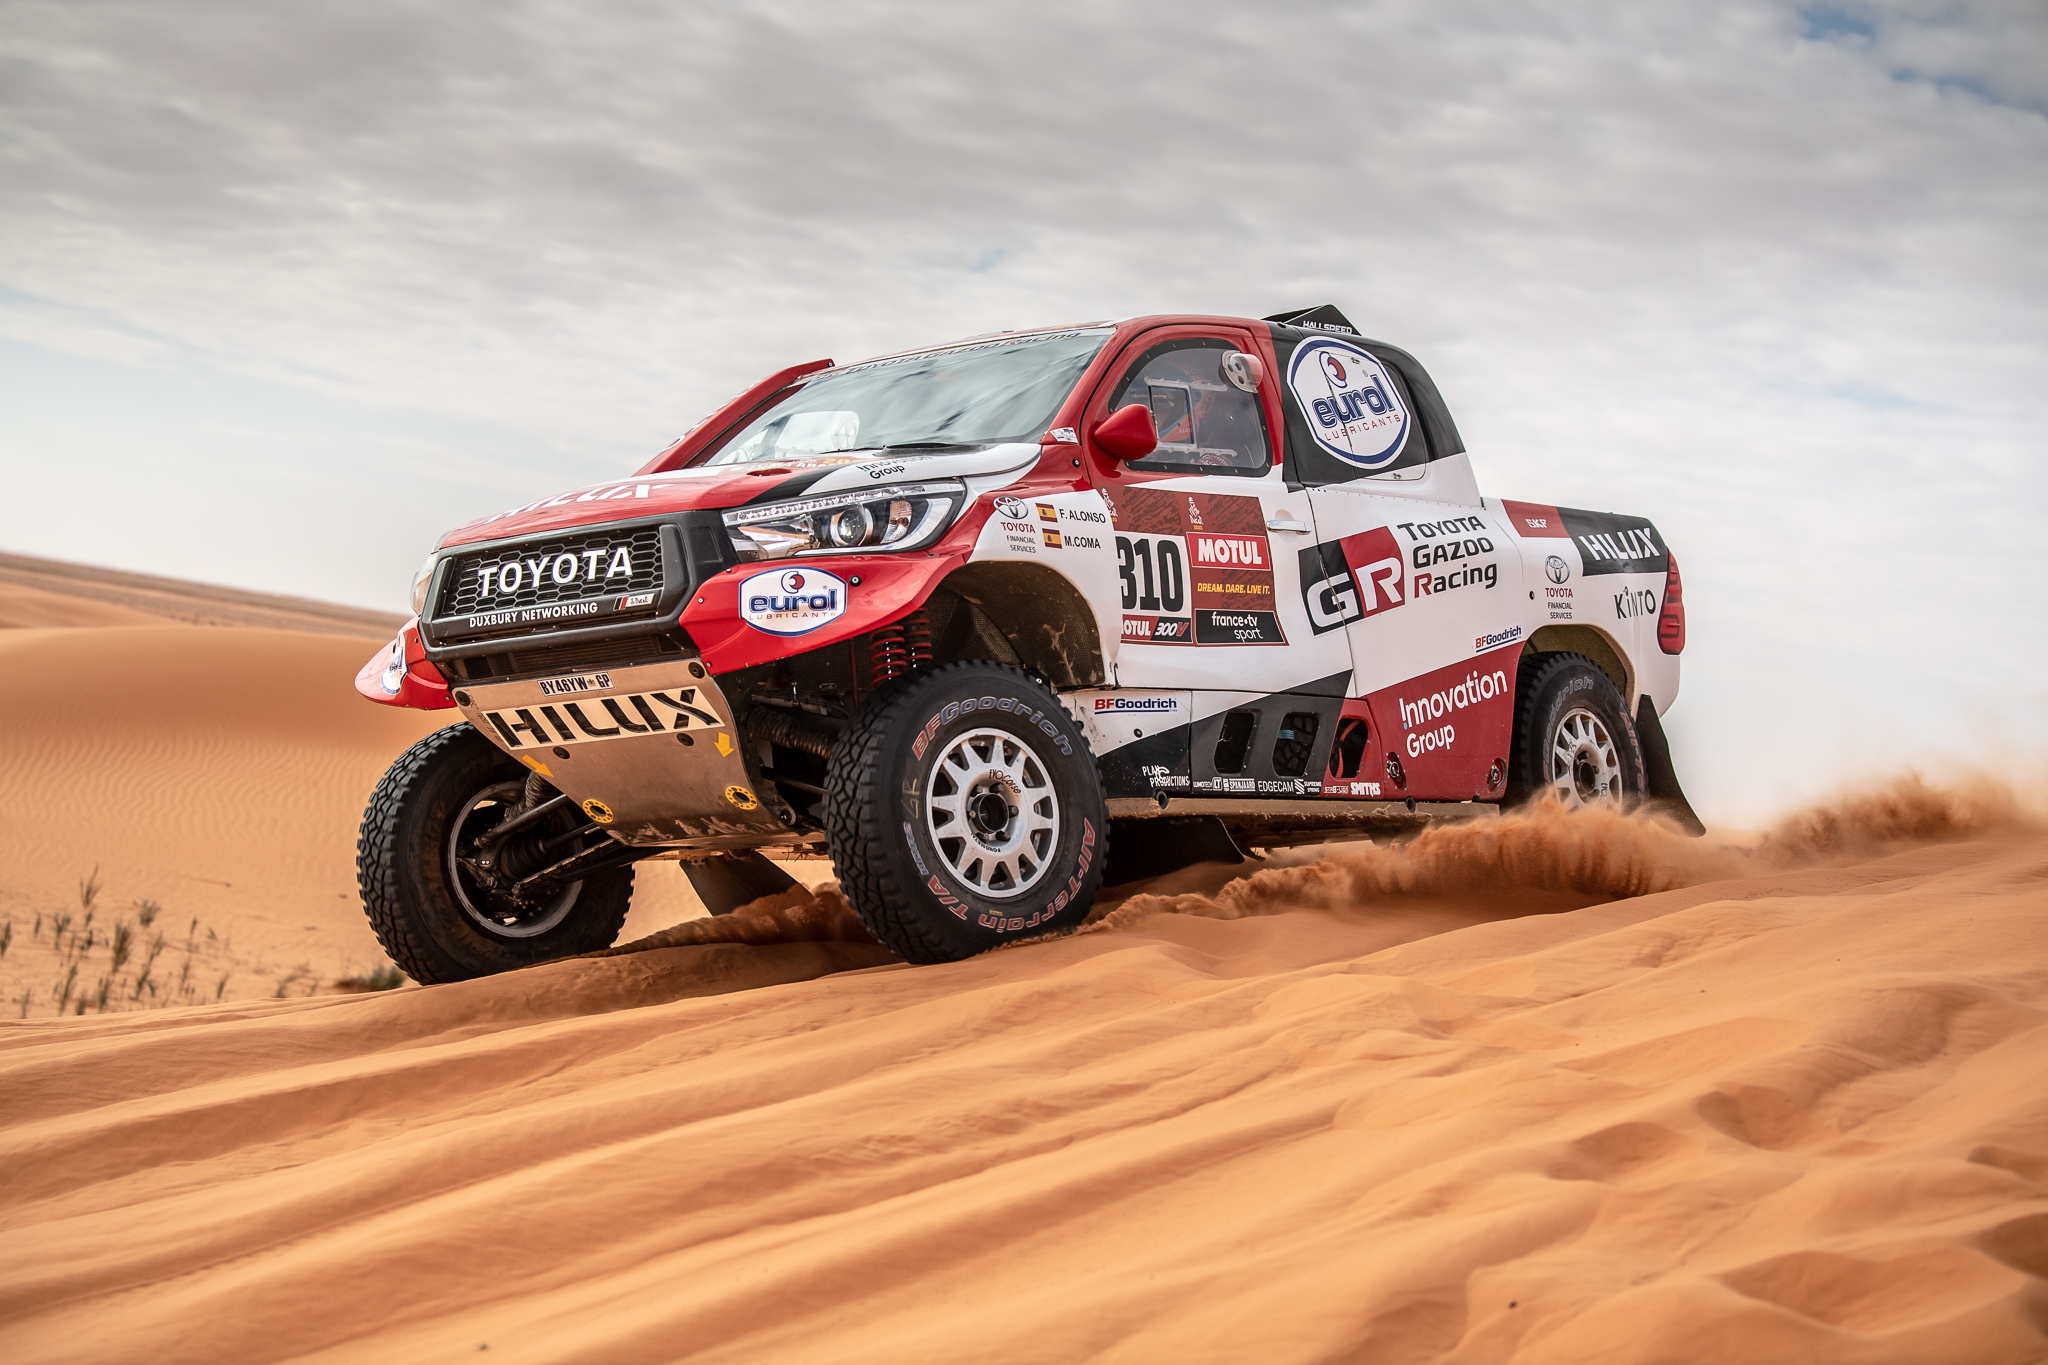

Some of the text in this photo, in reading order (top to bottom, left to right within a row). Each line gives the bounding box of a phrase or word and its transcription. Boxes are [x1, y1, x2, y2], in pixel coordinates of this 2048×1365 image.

[1303, 320, 1353, 335] HALLSPEED
[1312, 373, 1397, 429] eurol
[1324, 413, 1402, 442] LUBRICANTS
[869, 464, 906, 480] Group
[1000, 521, 1036, 534] TOYOTA
[1059, 509, 1107, 524] F. ALONSO
[1525, 518, 1548, 529] SKF
[1397, 515, 1487, 542] TOYOTA
[1006, 535, 1037, 545] FINANCIAL
[1009, 544, 1037, 554] SERVICES
[1578, 527, 1661, 561] HILUX
[1198, 538, 1263, 565] MOTUL
[1413, 537, 1495, 570] GAZOO
[477, 545, 635, 598] TOYOTA
[1413, 562, 1498, 599] Racing
[1197, 583, 1225, 593] DREAM.
[1225, 584, 1246, 594] DARE.
[1247, 585, 1261, 594] LIVE
[1306, 556, 1403, 629] GR
[1545, 587, 1574, 598] TOYOTA
[748, 588, 838, 613] eurol
[1547, 601, 1573, 610] FINANCIAL
[469, 601, 599, 628] DUXBURY NETWORKING
[749, 611, 837, 621] LUBRICANTS
[1550, 612, 1573, 620] SERVICES
[1155, 622, 1189, 637] 300V
[1233, 627, 1264, 643] sport
[1475, 625, 1522, 649] BFGoodrich
[540, 673, 611, 695] BY46YW GP
[1094, 698, 1177, 710] BFGoodrich
[1398, 670, 1508, 730] Innovation
[486, 688, 721, 748] HILUX
[912, 696, 1074, 761] BFGoodrich
[1406, 724, 1456, 758] Group
[1257, 780, 1294, 793] EDGECAM
